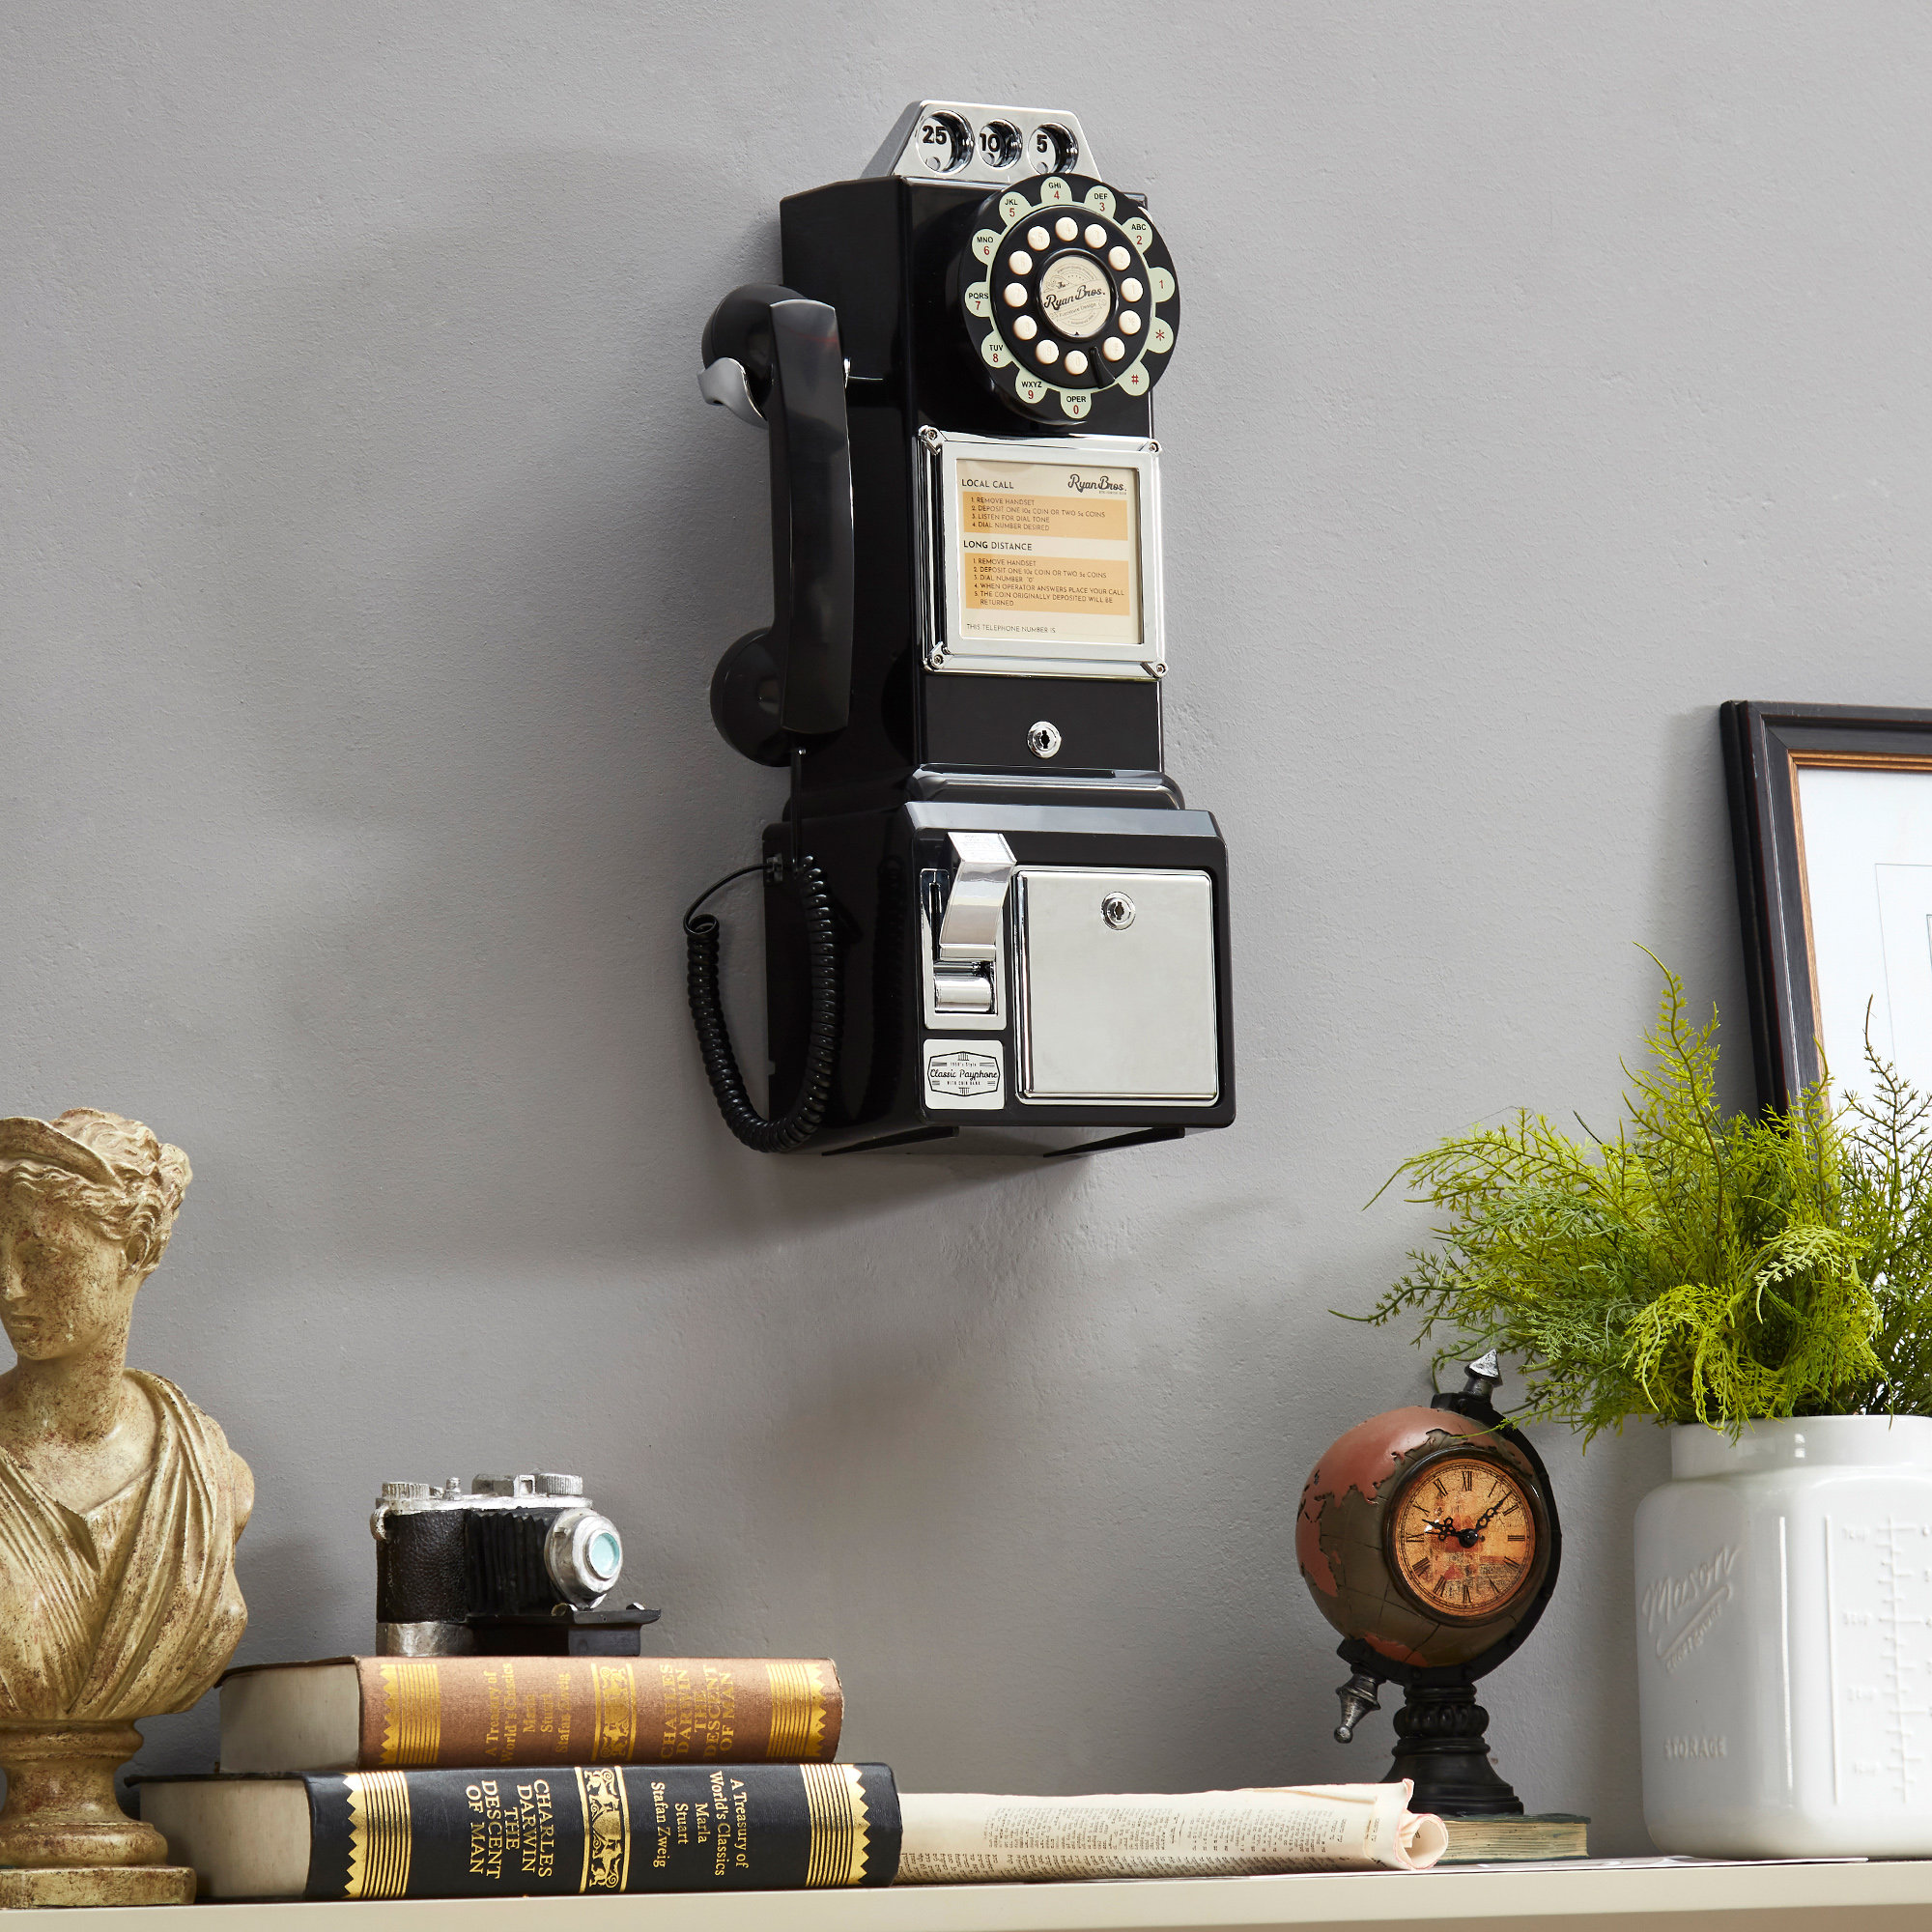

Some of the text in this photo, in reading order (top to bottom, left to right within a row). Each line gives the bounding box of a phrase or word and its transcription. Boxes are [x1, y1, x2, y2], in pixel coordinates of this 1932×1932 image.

[923, 126, 947, 145] 25
[980, 133, 1000, 153] 10
[1037, 133, 1048, 153] 5
[1009, 208, 1015, 217] 5
[1053, 190, 1060, 199] 4
[1099, 202, 1105, 212] 3
[983, 245, 989, 255] 6
[1136, 235, 1142, 245] 2
[1043, 284, 1105, 310] Ryan Bros.
[1159, 279, 1163, 289] 1
[975, 301, 980, 310] 7
[992, 354, 999, 363] 8
[1028, 390, 1034, 400] 9
[1073, 405, 1079, 414] 0
[962, 479, 989, 488] LOCAL
[1067, 473, 1126, 493] Ryan Bros.
[963, 540, 1033, 551] LONG DISTANCE
[929, 1068, 998, 1081] Classic Payphone
[484, 1670, 501, 1756] A Treasury of
[501, 1662, 517, 1762] World's Classics
[541, 1693, 554, 1733] Stuart
[660, 1663, 677, 1759] CHARLES
[675, 1669, 693, 1754] DARWIN
[694, 1690, 707, 1733] THE
[703, 1664, 721, 1758] DESCENT
[719, 1672, 734, 1751] OF MAN
[556, 1714, 571, 1753] Stafan
[466, 1785, 486, 1874] OF MAN
[481, 1779, 502, 1879] DESCENT
[504, 1806, 520, 1850] THE
[516, 1784, 537, 1873] DARWIN
[533, 1779, 554, 1878] CHARLES
[651, 1781, 670, 1868] Stafan Zweig
[675, 1803, 689, 1845] Stuart
[695, 1803, 711, 1844] Marla
[709, 1770, 731, 1876] World's Classics
[729, 1778, 750, 1868] A Treasury of
